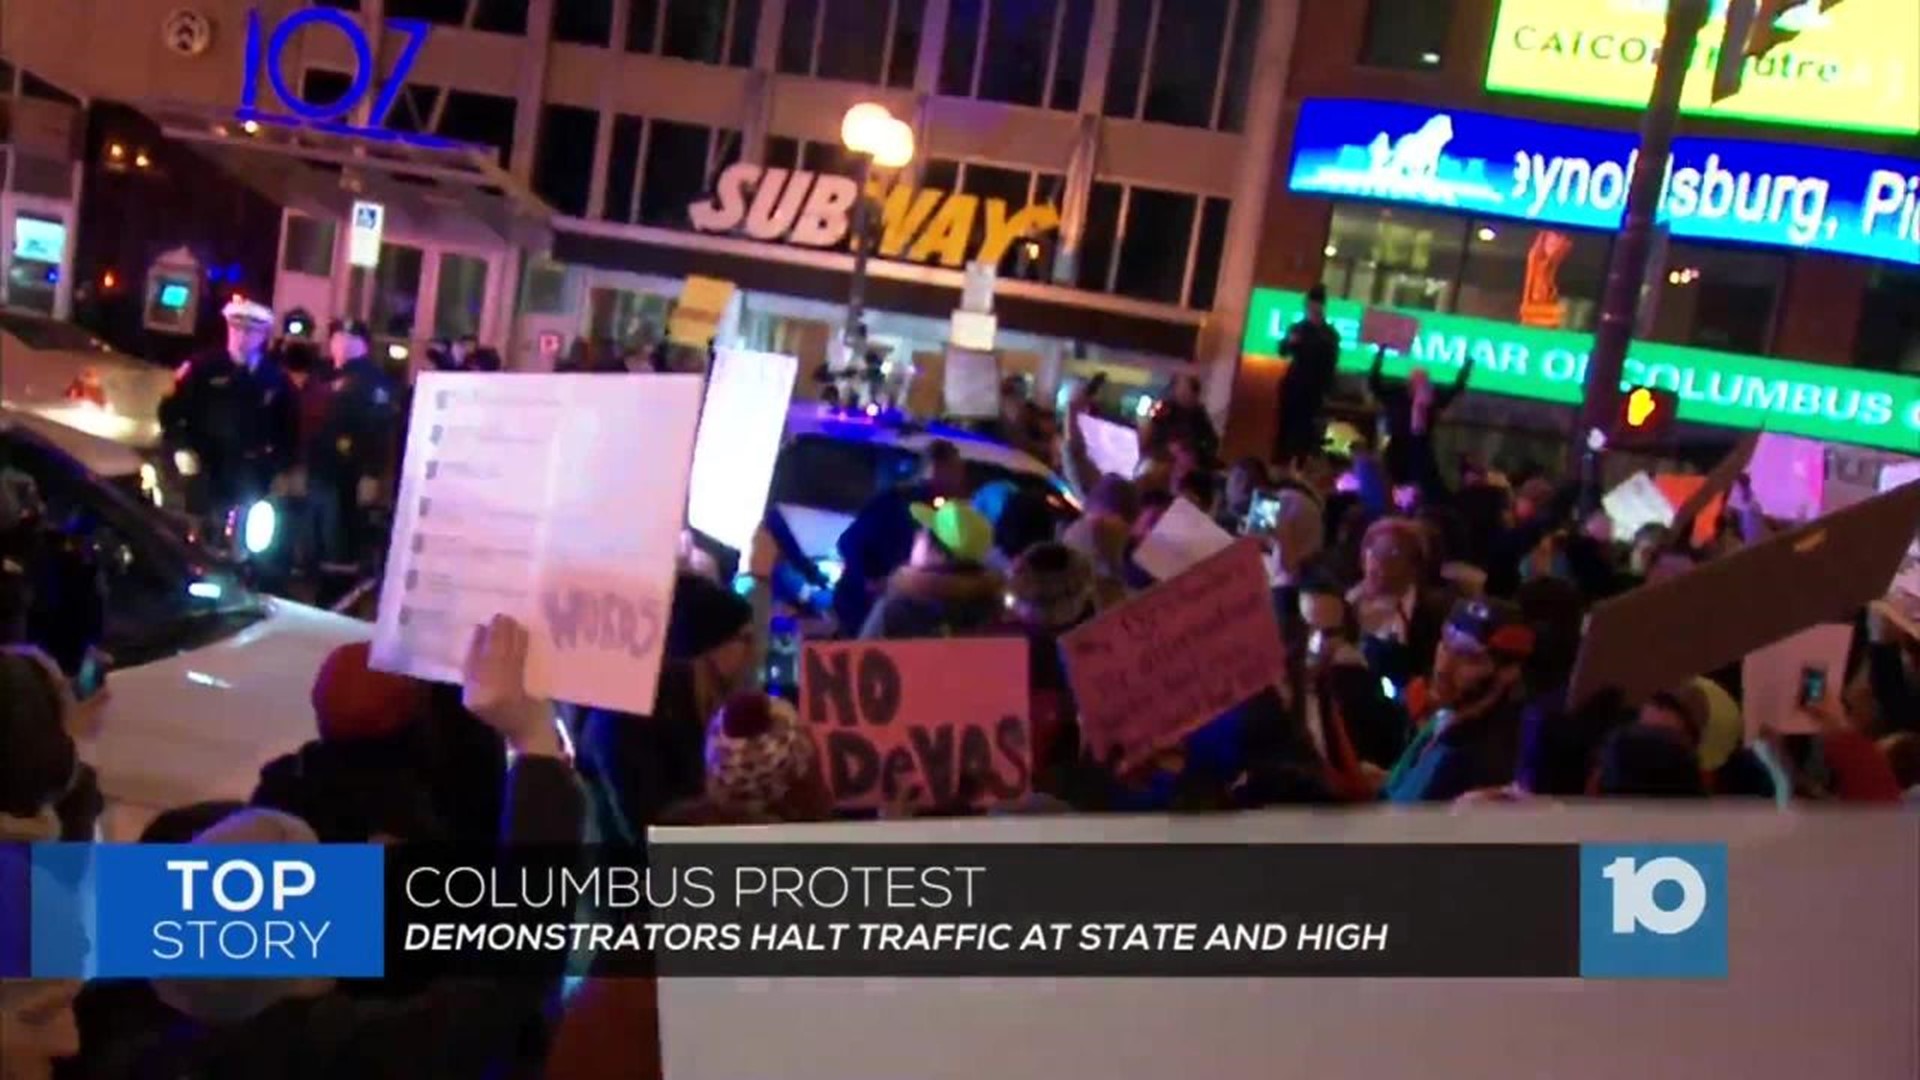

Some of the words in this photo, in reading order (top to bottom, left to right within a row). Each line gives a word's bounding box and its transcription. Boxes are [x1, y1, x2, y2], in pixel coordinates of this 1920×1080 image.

[238, 5, 431, 128] 107
[1268, 308, 1361, 350] LE
[805, 647, 902, 727] NO
